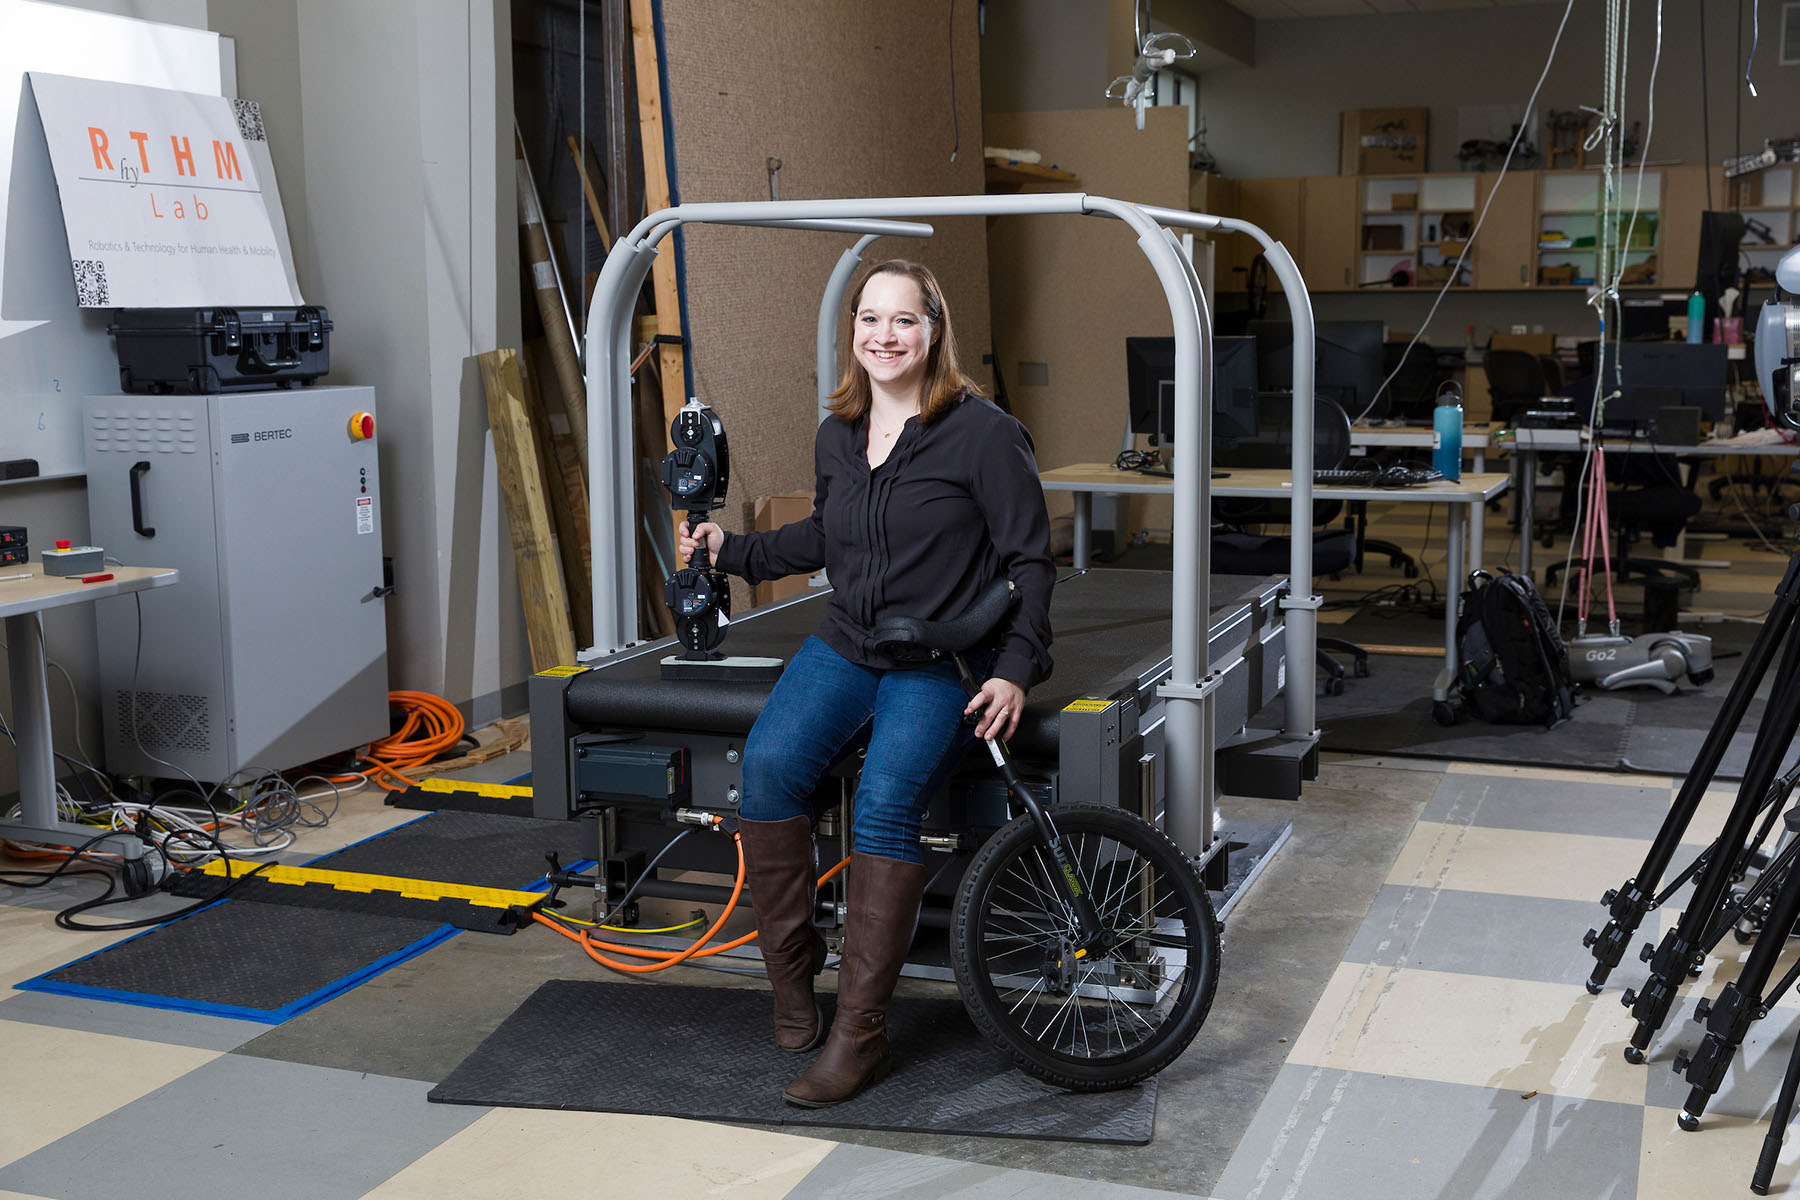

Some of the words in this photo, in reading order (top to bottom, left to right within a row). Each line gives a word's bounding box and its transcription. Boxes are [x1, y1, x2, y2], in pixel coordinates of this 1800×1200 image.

[150, 192, 209, 221] Lab
[88, 240, 122, 252] Robotics
[125, 242, 130, 252] &
[132, 241, 176, 256] Technology
[177, 242, 188, 253] for
[190, 243, 218, 254] Human
[219, 244, 241, 256] Health
[243, 246, 249, 256] &
[254, 428, 293, 442] BERTEC
[1585, 648, 1617, 662] Go2
